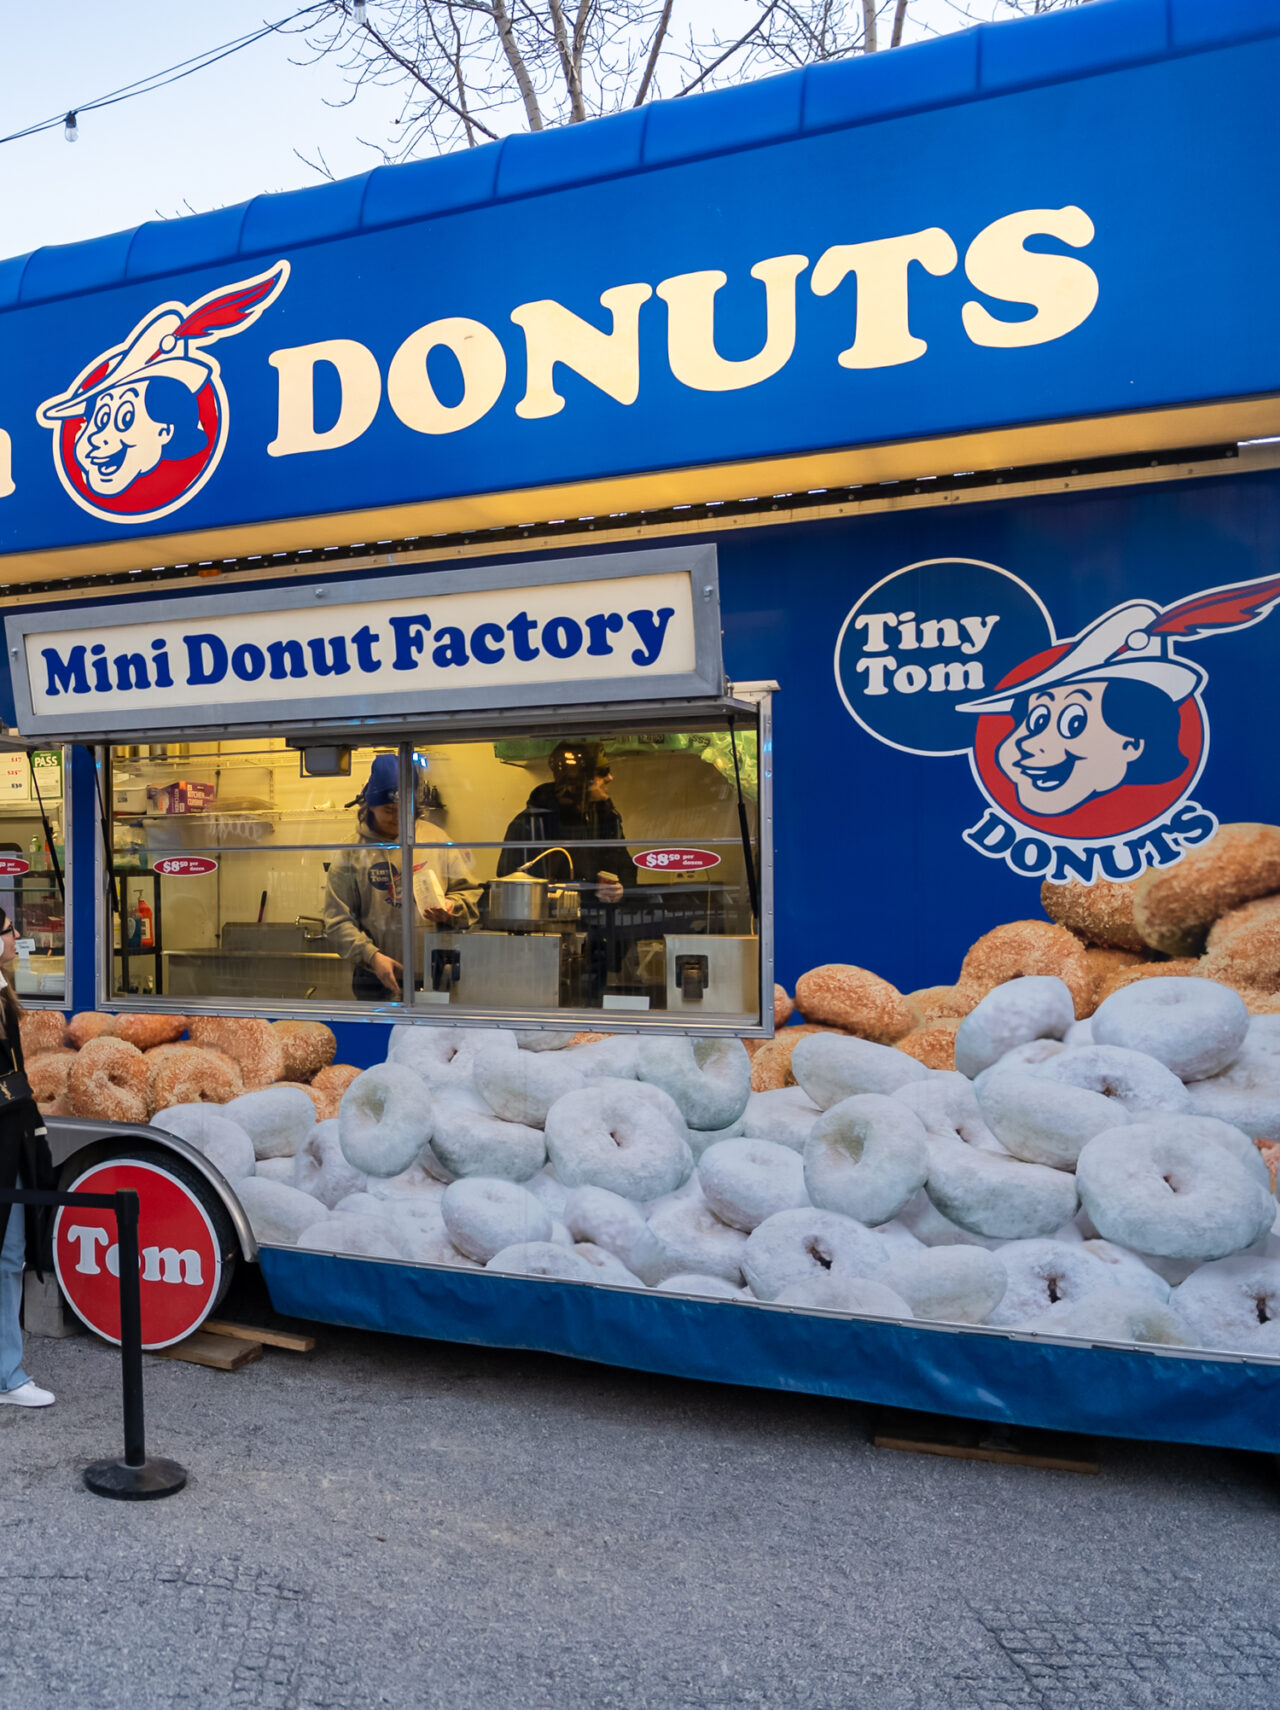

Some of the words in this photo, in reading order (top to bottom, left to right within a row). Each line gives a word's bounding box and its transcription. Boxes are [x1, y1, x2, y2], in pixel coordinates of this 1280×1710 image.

[267, 204, 1099, 458] DONUTS
[41, 638, 174, 696] Mini
[184, 624, 382, 686] Donut
[390, 607, 675, 671] Factory
[855, 611, 1000, 654] Tiny
[856, 656, 985, 695] Tom
[34, 756, 58, 768] PASS
[964, 801, 1218, 885] DONUTS
